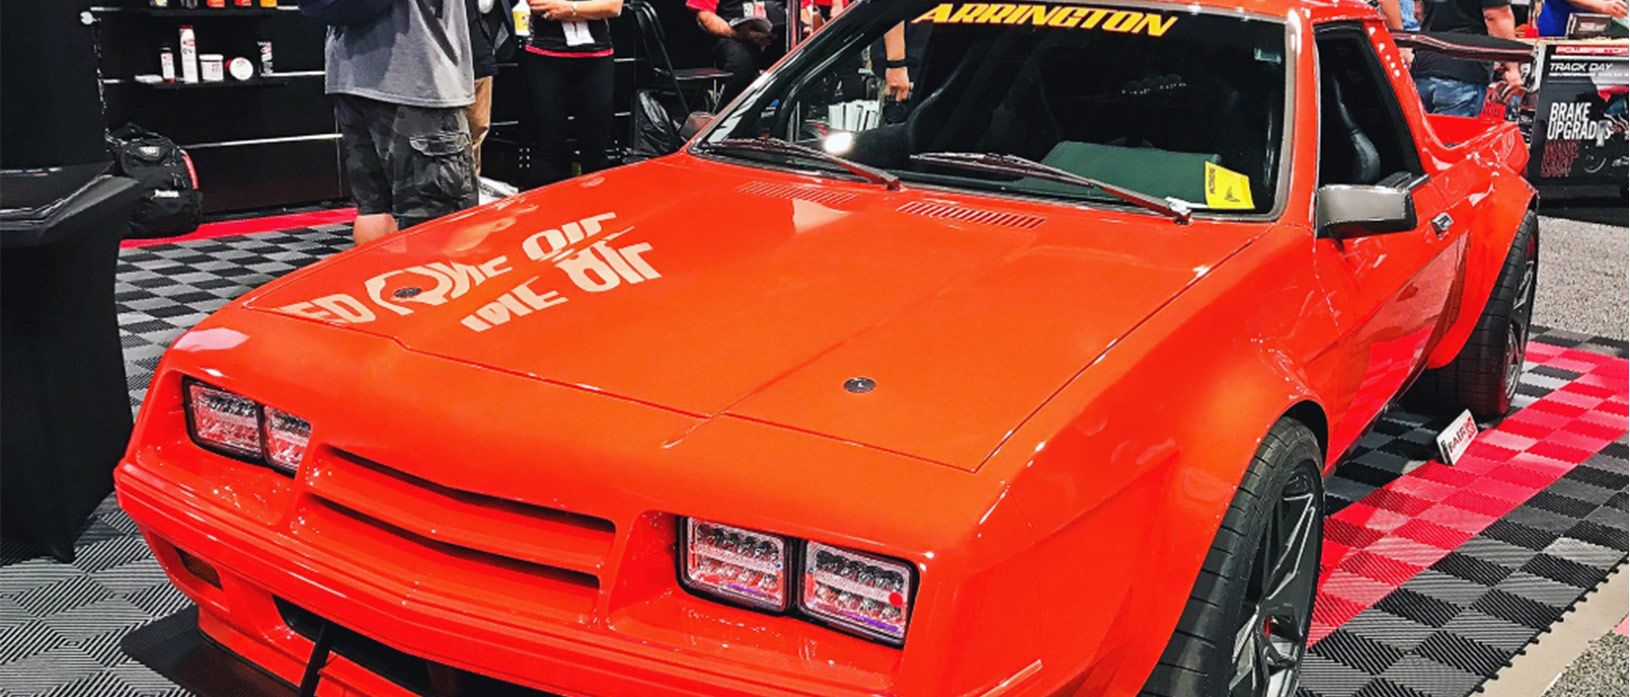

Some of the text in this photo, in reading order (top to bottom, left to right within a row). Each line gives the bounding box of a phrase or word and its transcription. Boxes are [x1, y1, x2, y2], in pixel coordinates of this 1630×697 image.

[912, 3, 1178, 37] ARRINGTON
[1550, 62, 1613, 72] TRACK DAY
[1550, 102, 1591, 121] BRAKE
[1547, 120, 1613, 140] UPGRADS
